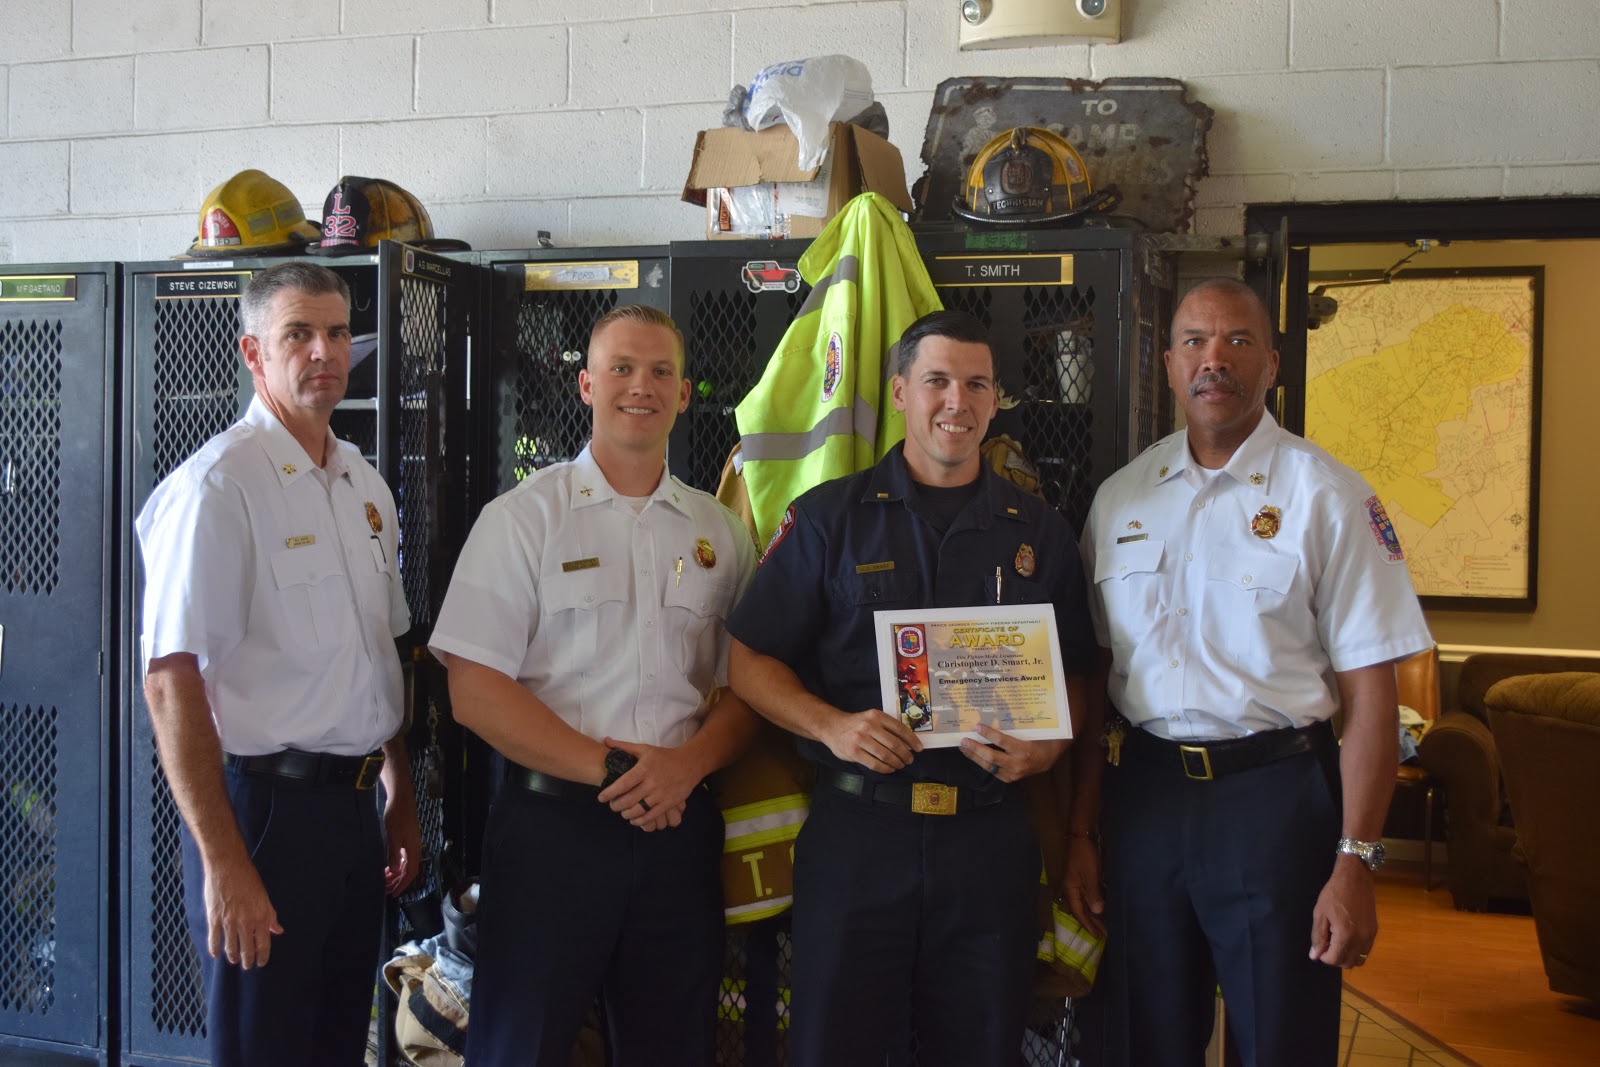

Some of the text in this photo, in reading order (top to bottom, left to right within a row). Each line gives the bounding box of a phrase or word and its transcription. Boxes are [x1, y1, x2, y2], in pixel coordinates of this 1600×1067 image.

[1081, 99, 1118, 116] TO
[332, 193, 351, 214] L
[992, 199, 1043, 210] TECHNICIAN
[325, 215, 357, 237] 32
[965, 264, 1020, 277] T. SMITH
[169, 280, 237, 291] STEVE CIZEWSKI
[953, 626, 1006, 634] CERTIFICATE
[949, 632, 1026, 648] AWARD
[937, 660, 987, 669] Christopher
[741, 851, 773, 898] T.
